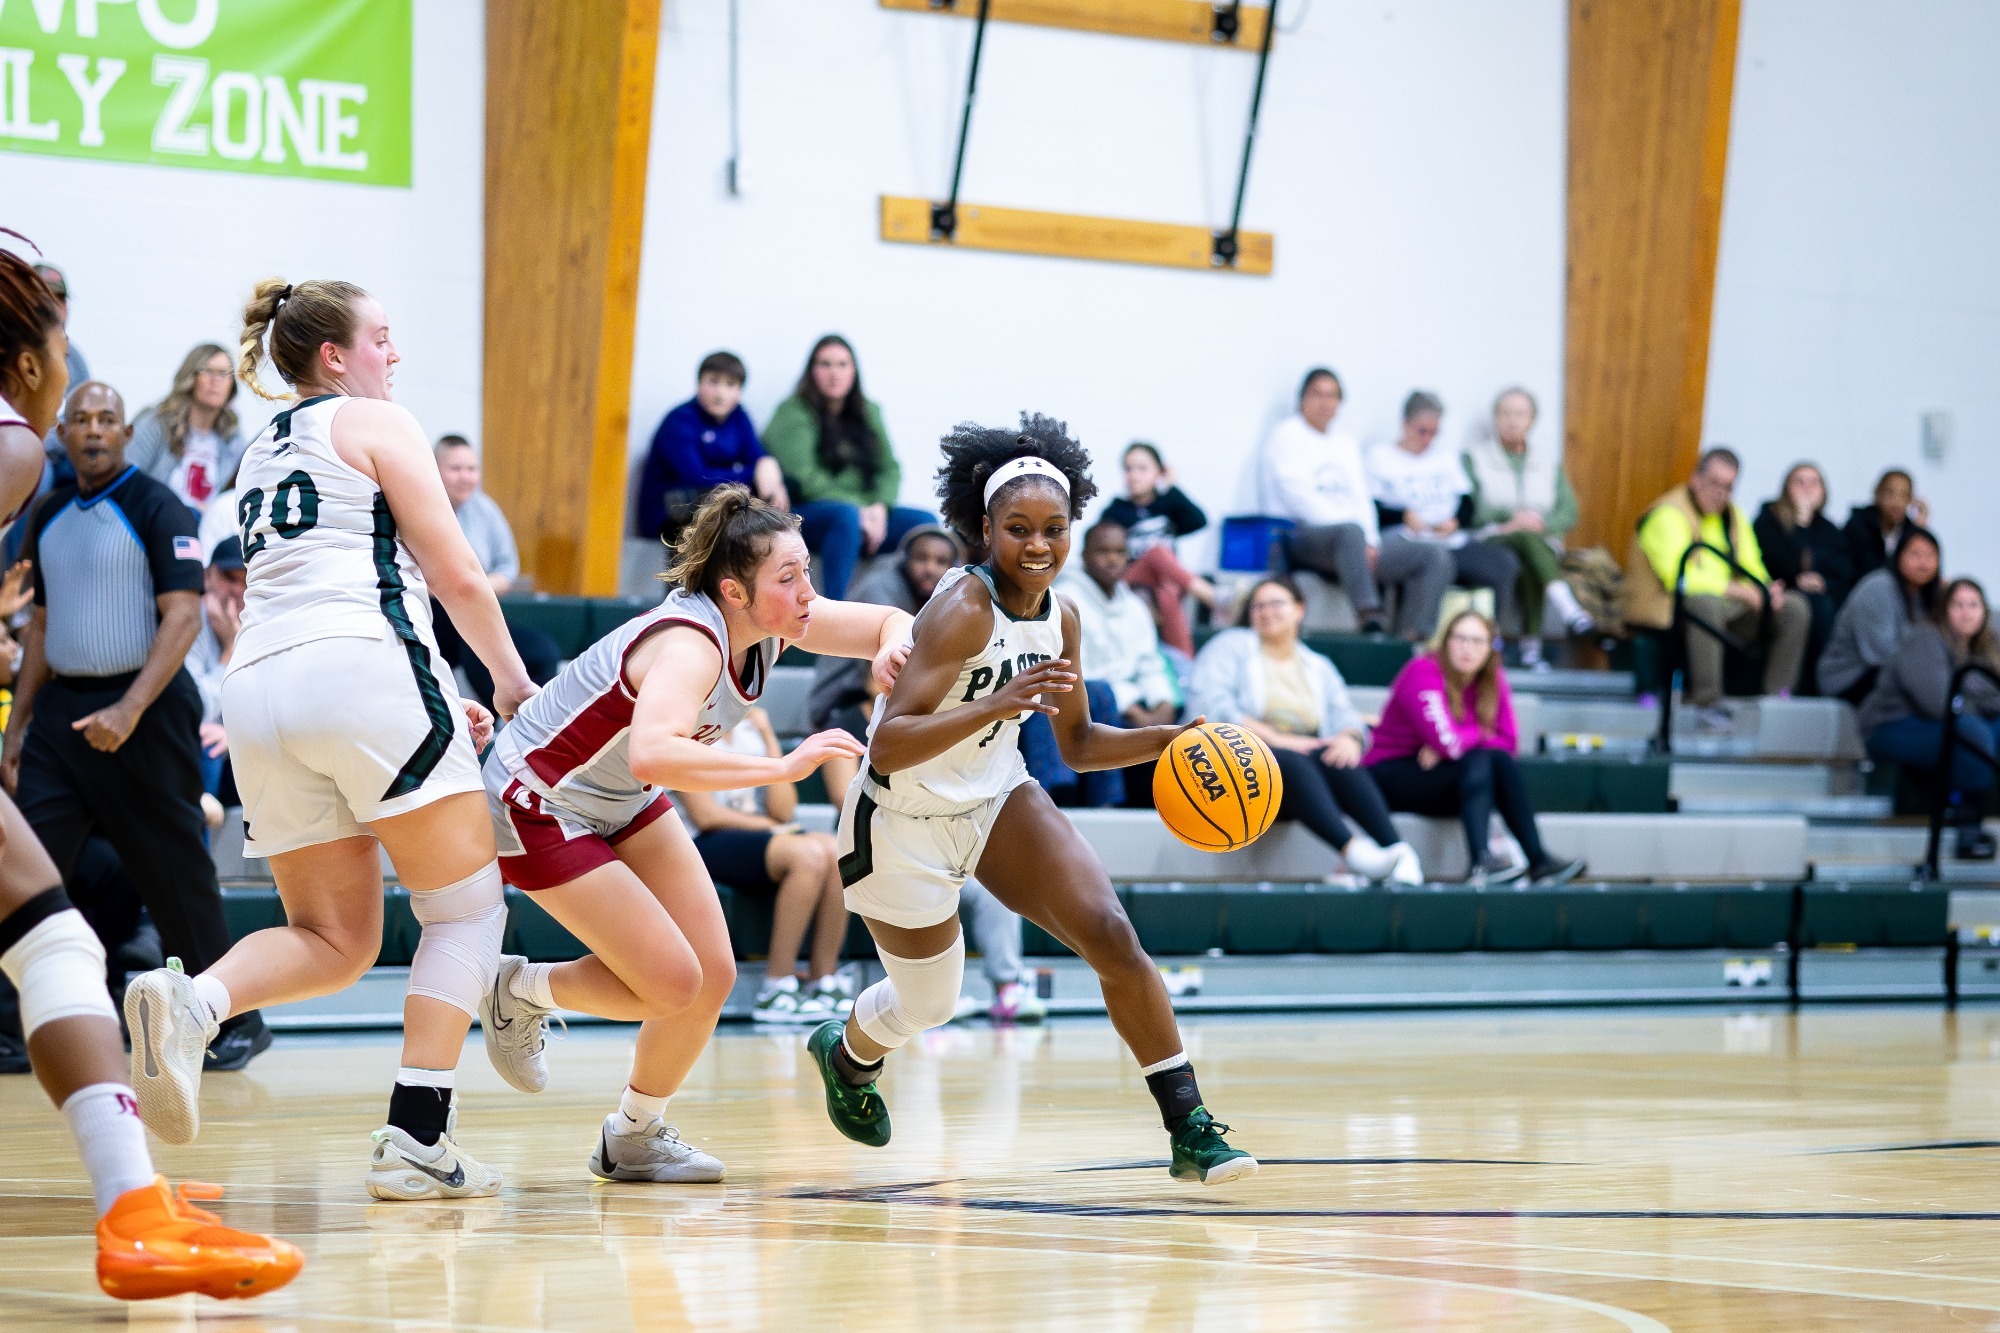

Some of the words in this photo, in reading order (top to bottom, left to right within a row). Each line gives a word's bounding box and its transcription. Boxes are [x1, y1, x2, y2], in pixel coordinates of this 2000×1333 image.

[0, 46, 127, 147] LY
[151, 54, 368, 170] ZONE
[238, 469, 324, 563] 20
[1184, 742, 1227, 803] NCAA
[1213, 724, 1261, 800] Wilson
